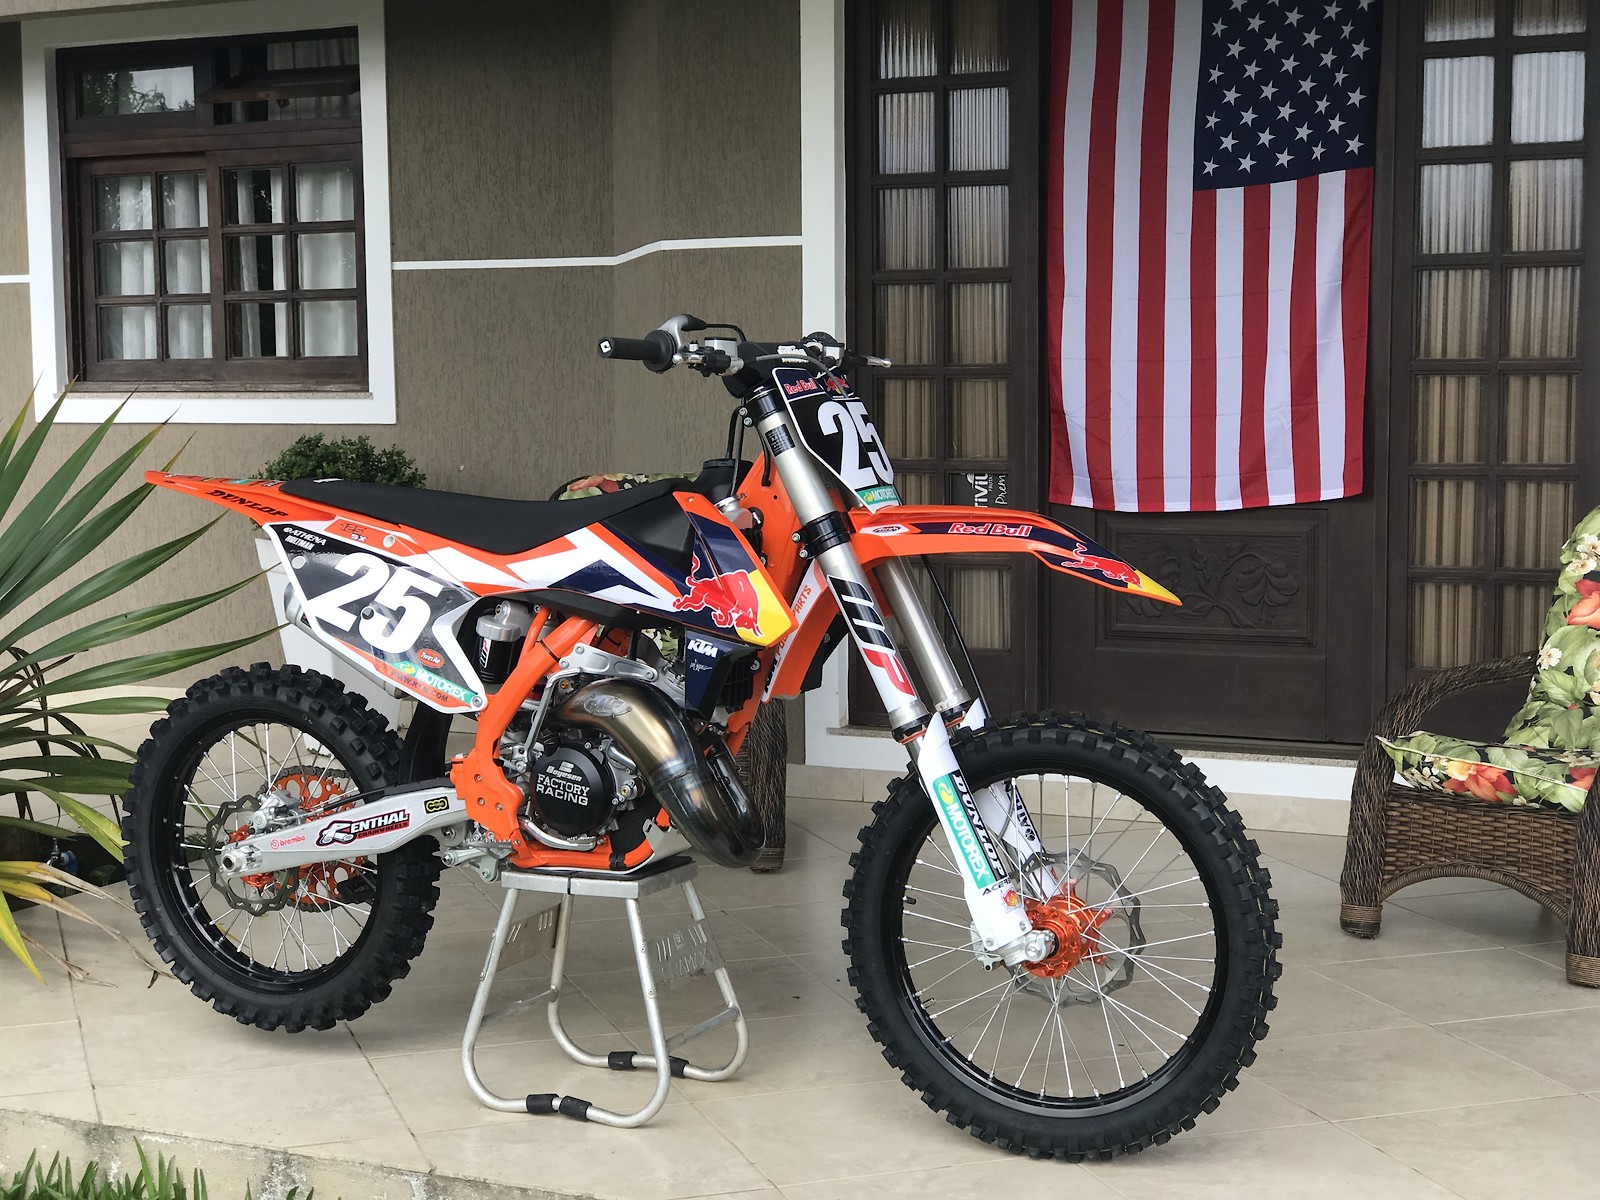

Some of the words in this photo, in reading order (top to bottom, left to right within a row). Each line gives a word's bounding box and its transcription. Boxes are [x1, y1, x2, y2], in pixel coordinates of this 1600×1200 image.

[783, 381, 802, 396] Red
[801, 377, 819, 393] Bull
[817, 399, 895, 489] 25
[204, 489, 289, 517] DUNLOP
[292, 529, 327, 546] ATHENA
[948, 522, 991, 536] Red
[991, 524, 1032, 537] Bull
[306, 552, 445, 653] 25
[420, 651, 433, 663] Twin
[687, 638, 718, 658] KTM
[415, 669, 468, 701] MOTOREX
[537, 773, 590, 797] FACTORY
[546, 765, 583, 782] Boyesen
[536, 783, 589, 806] RACING
[320, 811, 409, 844] RENTHAL
[952, 771, 1008, 878] DUNLOP
[279, 834, 306, 847] brembo
[946, 803, 990, 881] MOTOREX
